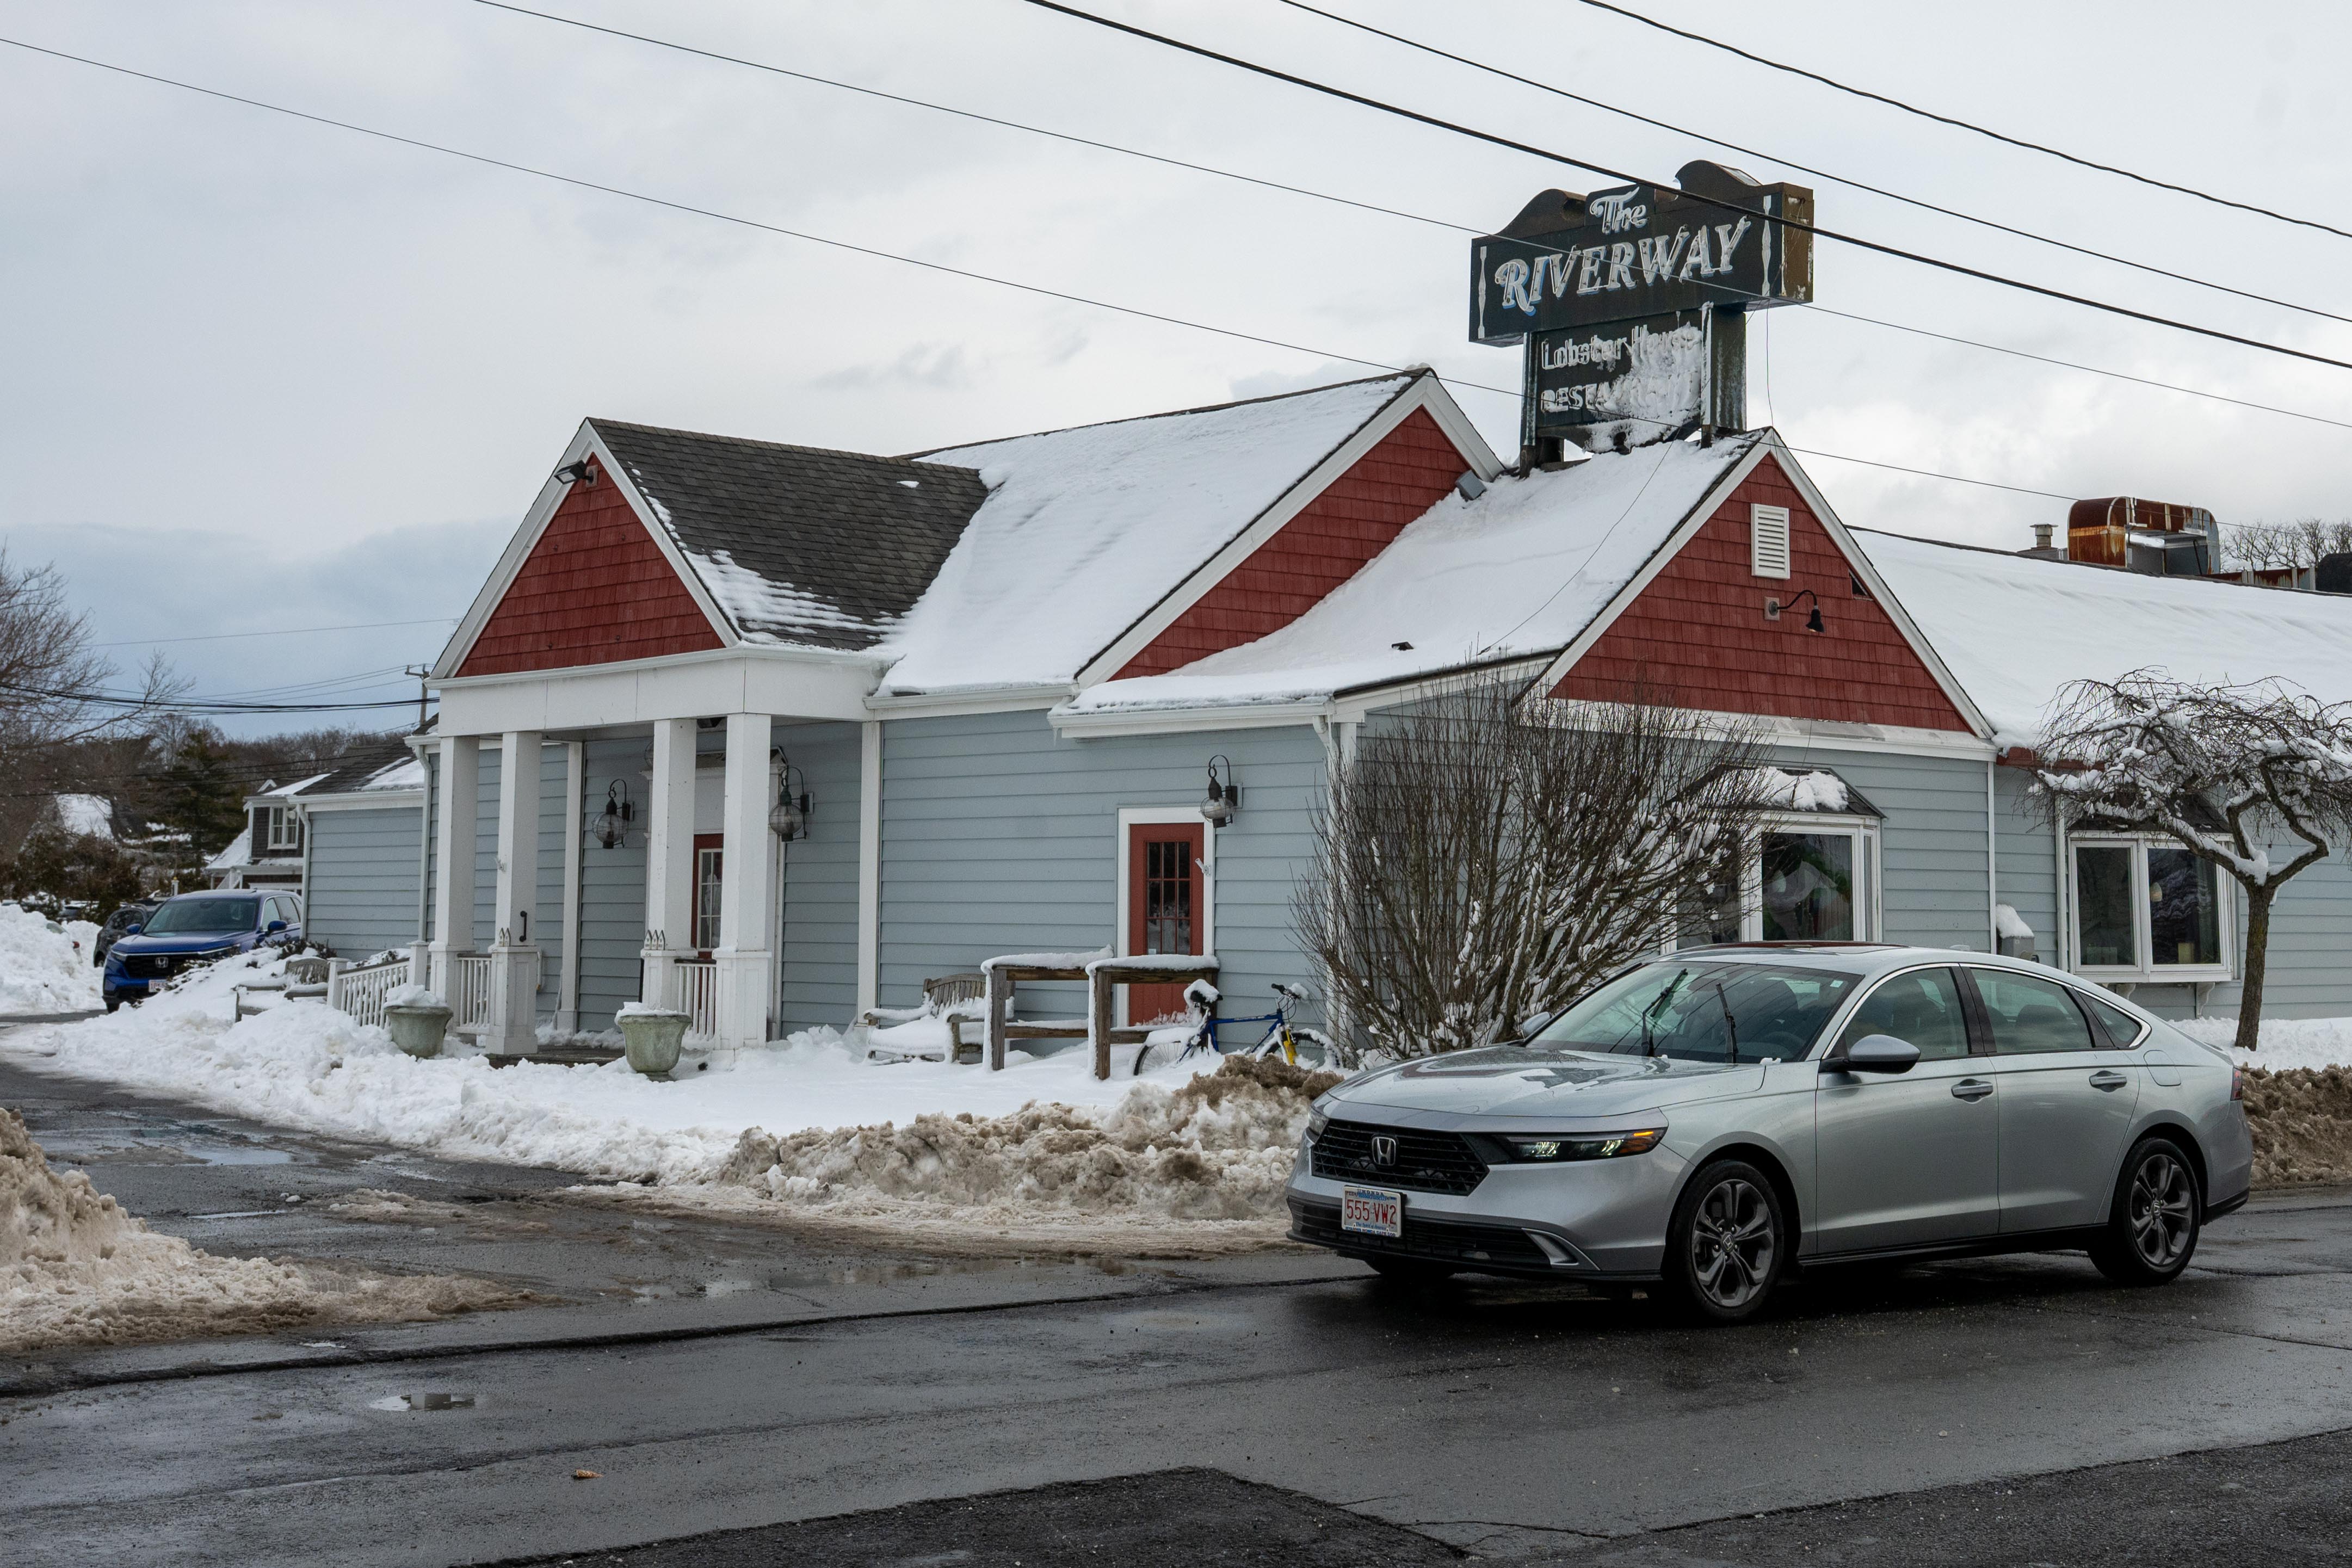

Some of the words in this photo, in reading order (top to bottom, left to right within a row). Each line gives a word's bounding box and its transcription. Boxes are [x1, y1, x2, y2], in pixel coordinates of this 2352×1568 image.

[1589, 187, 1649, 234] The
[1495, 215, 1752, 316] RIVERWAY
[1541, 334, 1627, 370] Lobster
